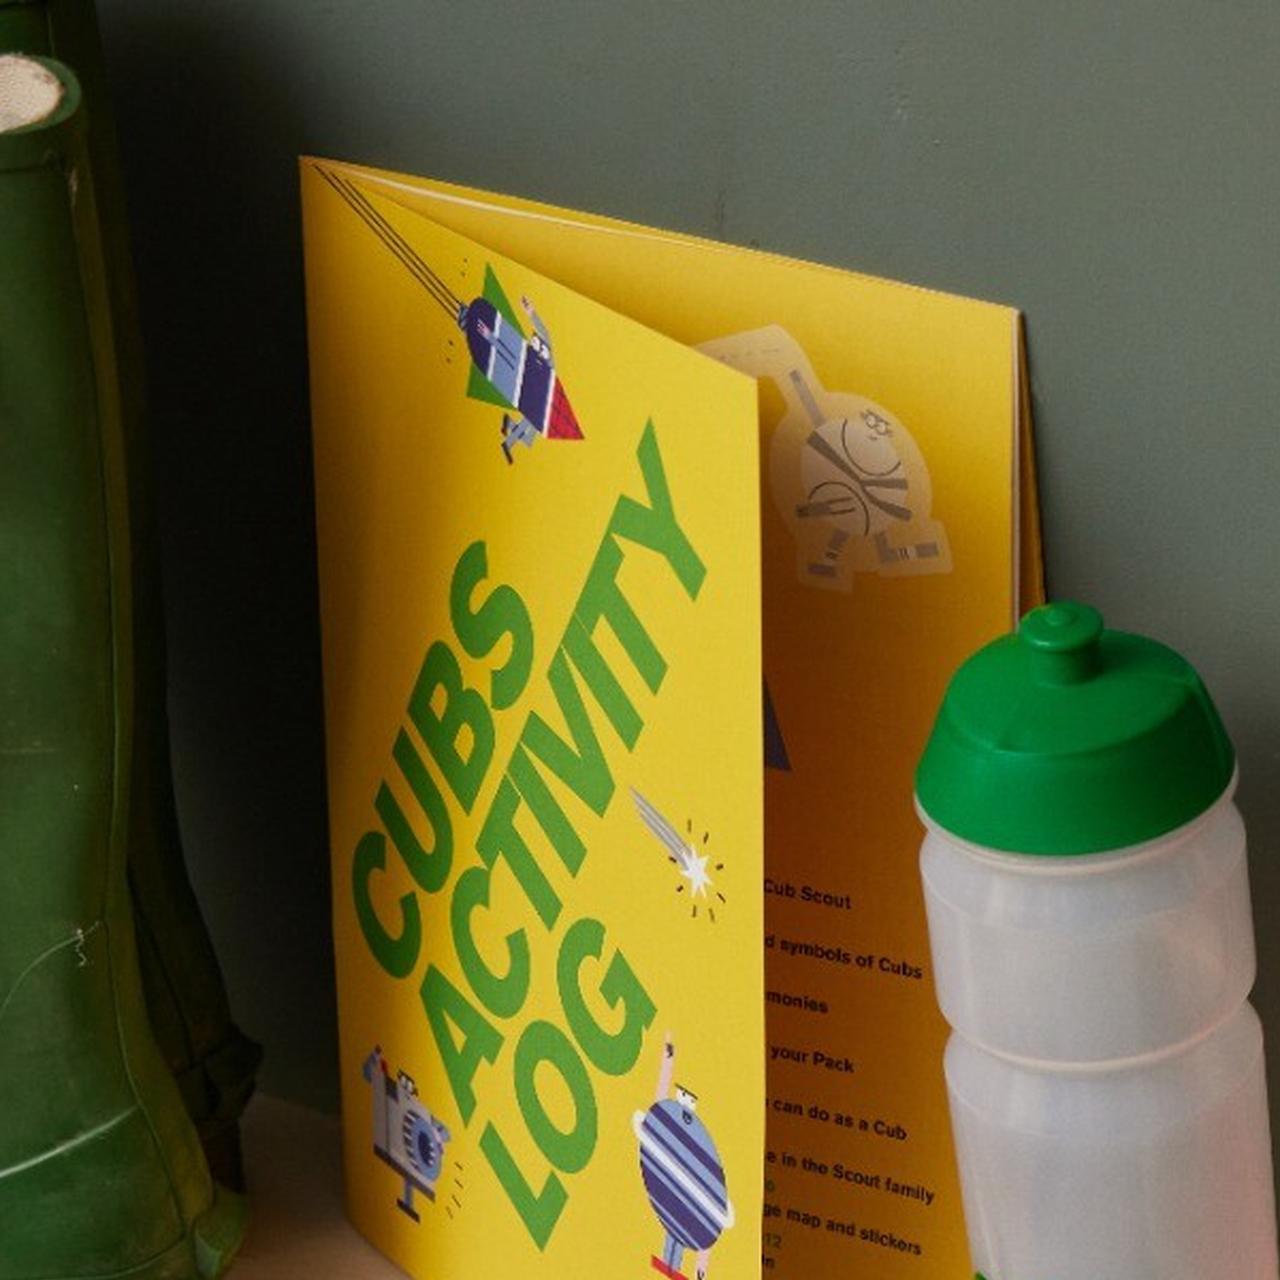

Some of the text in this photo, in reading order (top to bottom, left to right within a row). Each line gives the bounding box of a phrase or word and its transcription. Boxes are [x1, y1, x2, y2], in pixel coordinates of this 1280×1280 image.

[353, 540, 534, 979] CUBS
[418, 417, 707, 1128] ACTIVITY
[764, 878, 852, 910] Cub Scout
[780, 938, 852, 965] symbols
[855, 954, 875, 970] of
[878, 956, 923, 980] Cubs
[770, 1045, 855, 1074] your Pack
[477, 917, 658, 1253] LOG
[773, 1099, 908, 1141] can do as a Cub
[782, 1151, 797, 1168] in
[801, 1157, 829, 1176] the
[832, 1163, 881, 1189] Scout
[885, 1177, 935, 1207] family
[786, 1208, 822, 1229] map
[825, 1218, 856, 1237] and
[859, 1227, 923, 1256] stickers
